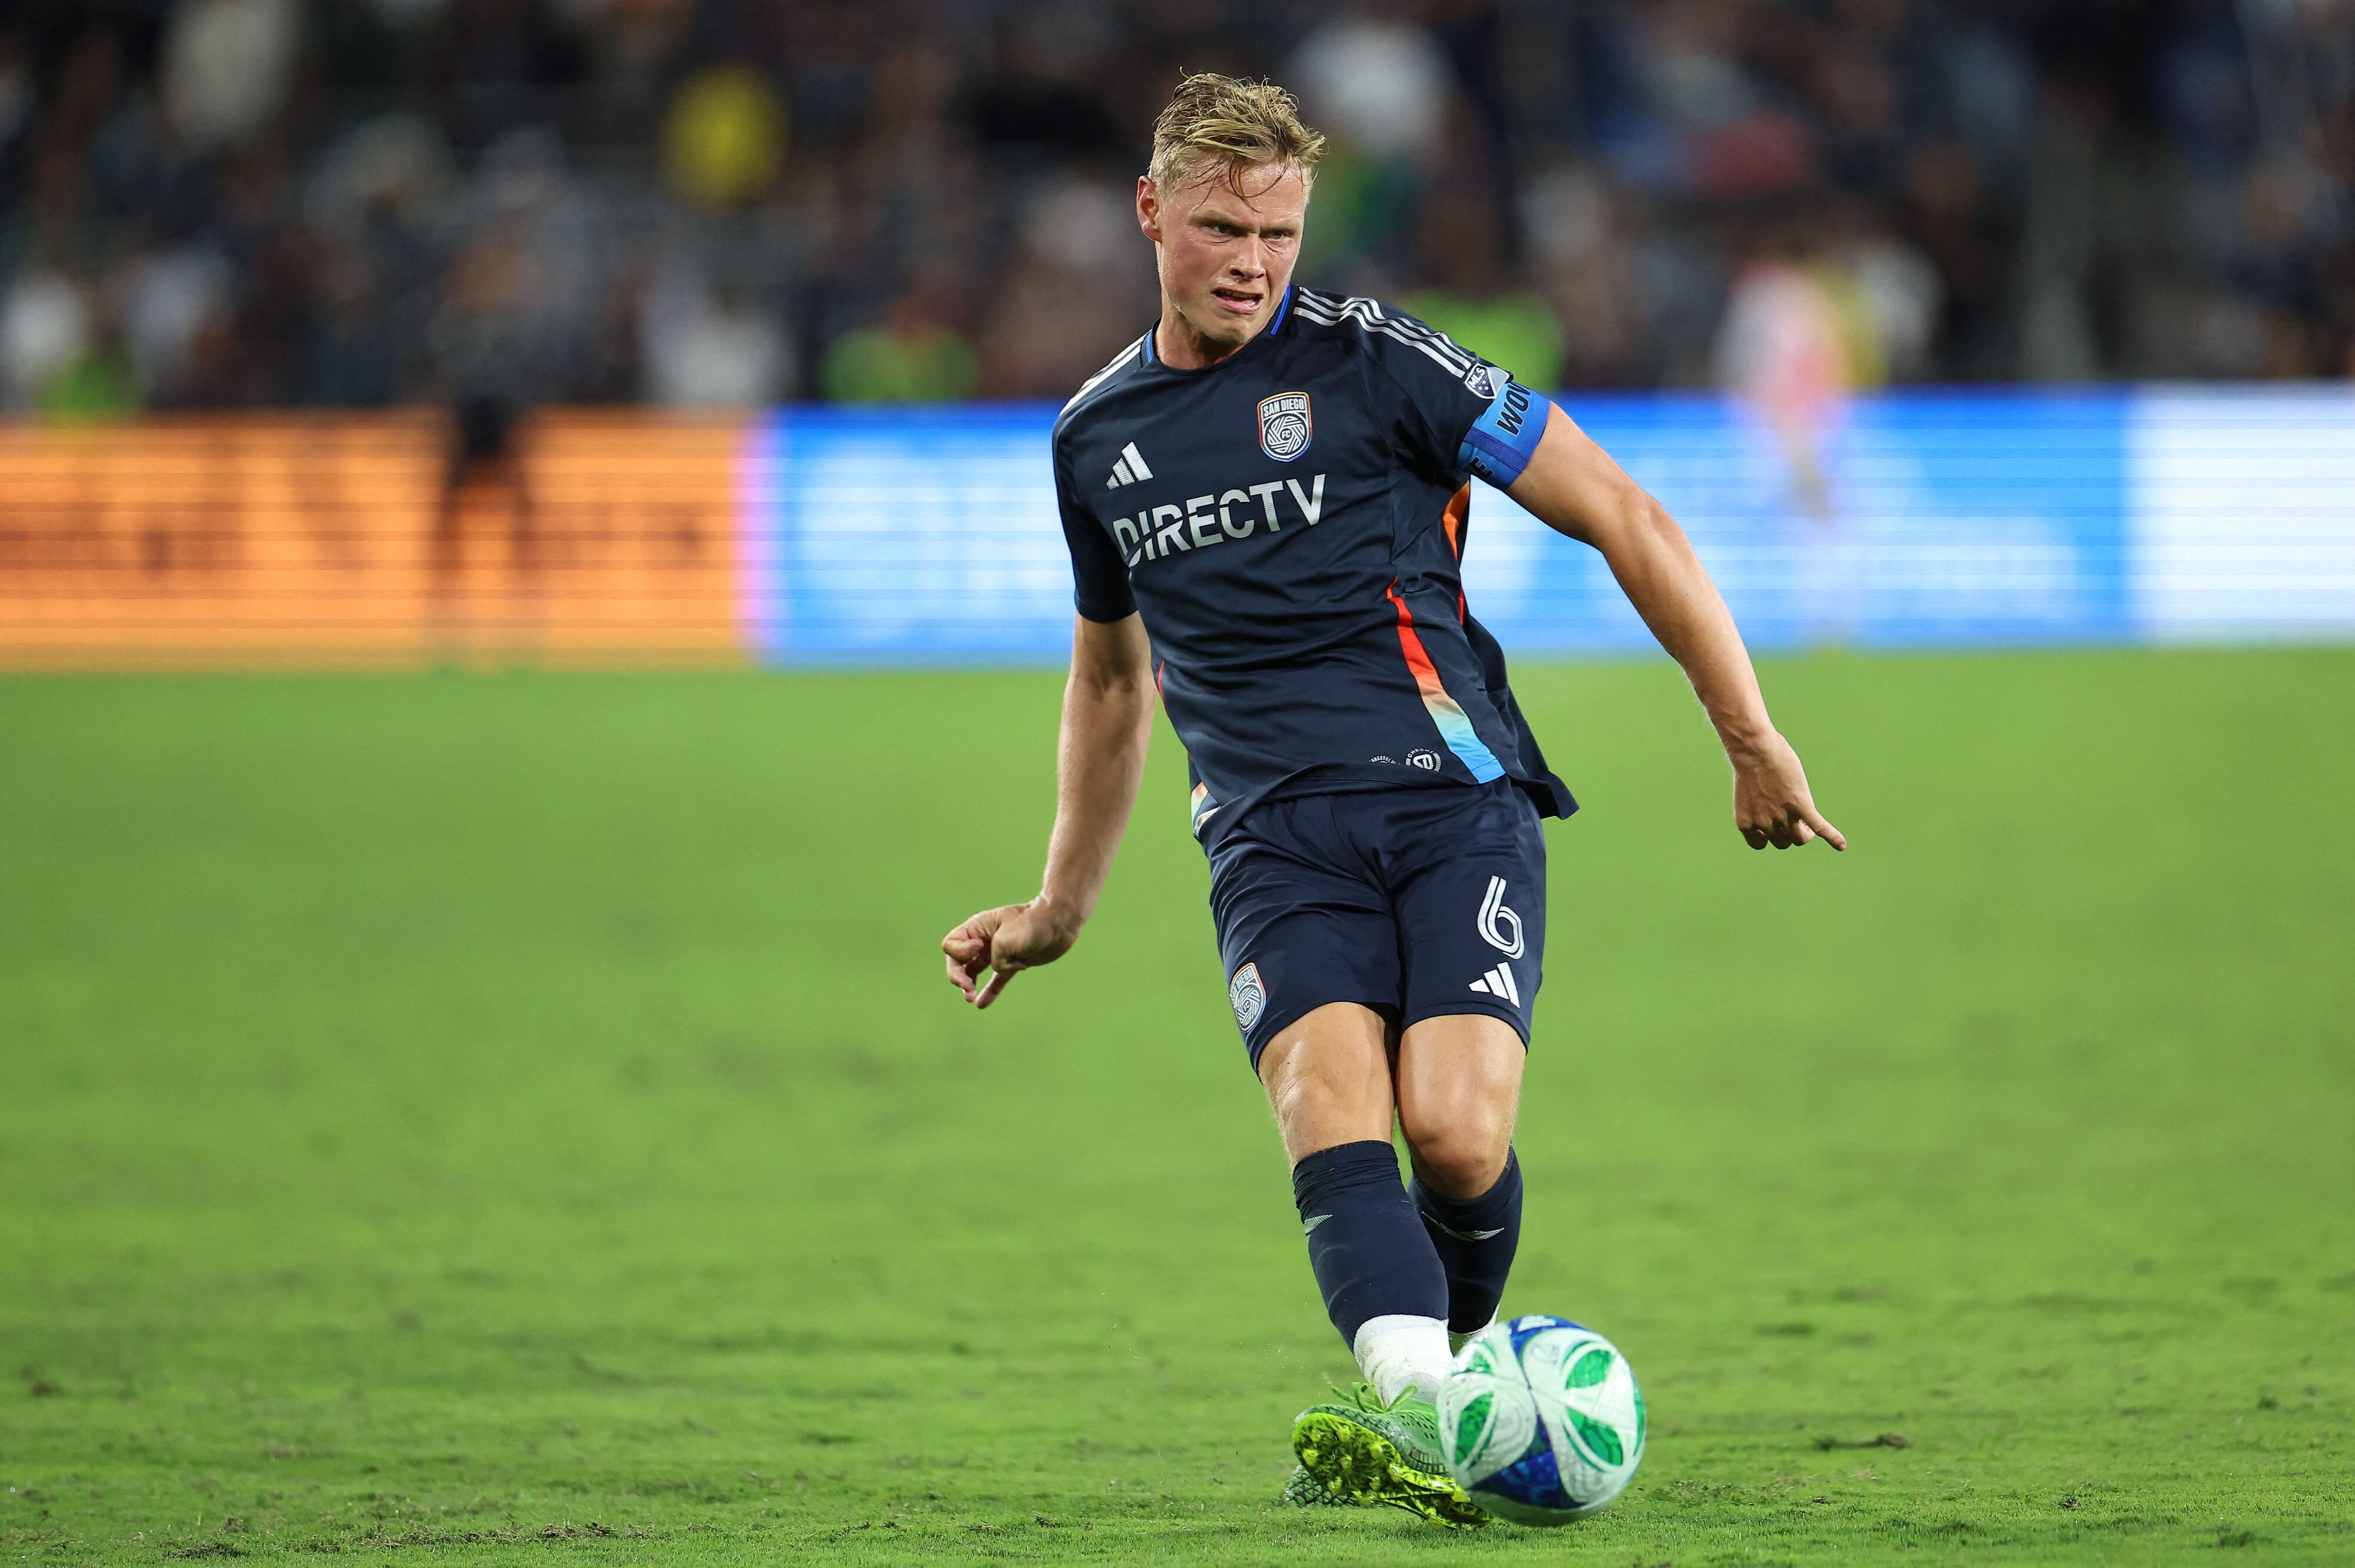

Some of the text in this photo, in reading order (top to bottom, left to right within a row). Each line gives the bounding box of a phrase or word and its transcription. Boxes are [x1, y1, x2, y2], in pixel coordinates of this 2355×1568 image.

[1468, 367, 1485, 388] MLS
[1263, 398, 1305, 417] SAN DIEGO
[1281, 430, 1291, 439] FC
[1113, 474, 1326, 567] DIRECTV
[1477, 875, 1525, 960] 6
[1236, 969, 1253, 989] DIEGO
